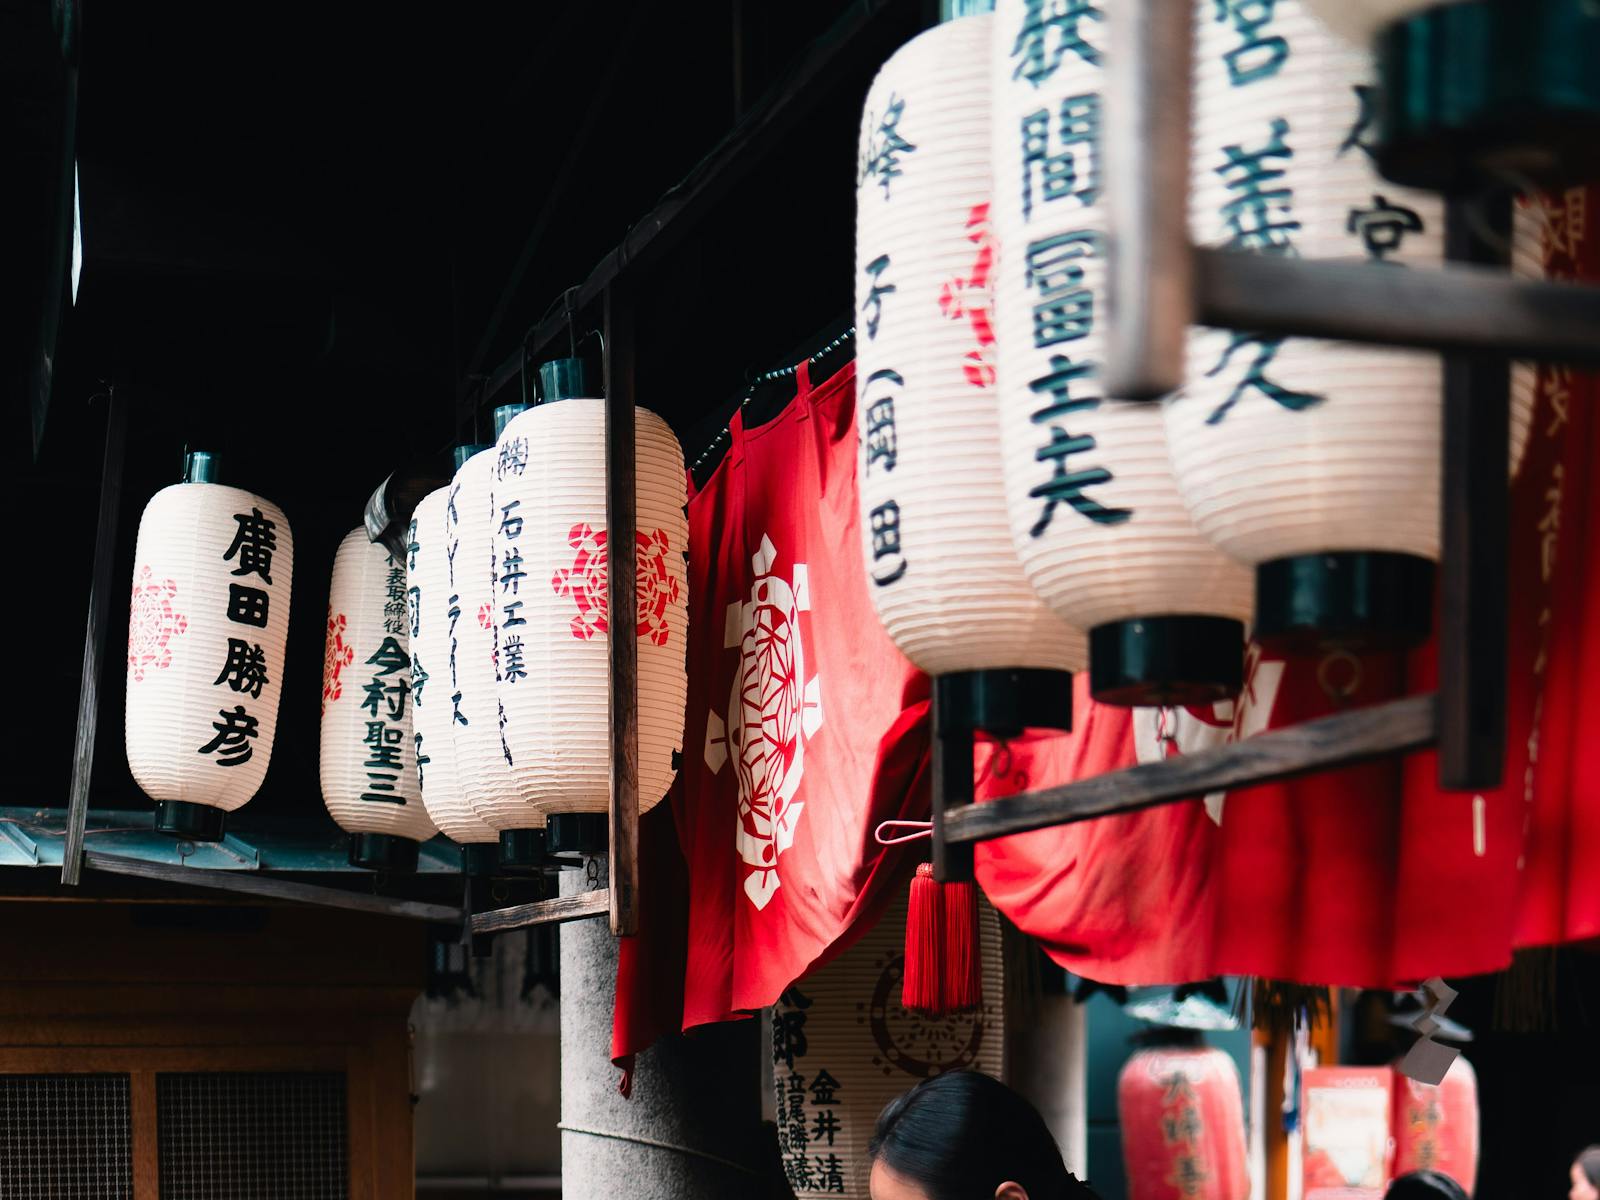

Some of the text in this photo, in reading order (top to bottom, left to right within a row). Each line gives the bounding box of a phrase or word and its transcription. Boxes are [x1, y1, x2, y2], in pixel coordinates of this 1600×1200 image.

[198, 506, 278, 768] 廣田勝彦
[360, 636, 412, 806] 今村聖三
[809, 1068, 844, 1193] 金井清
